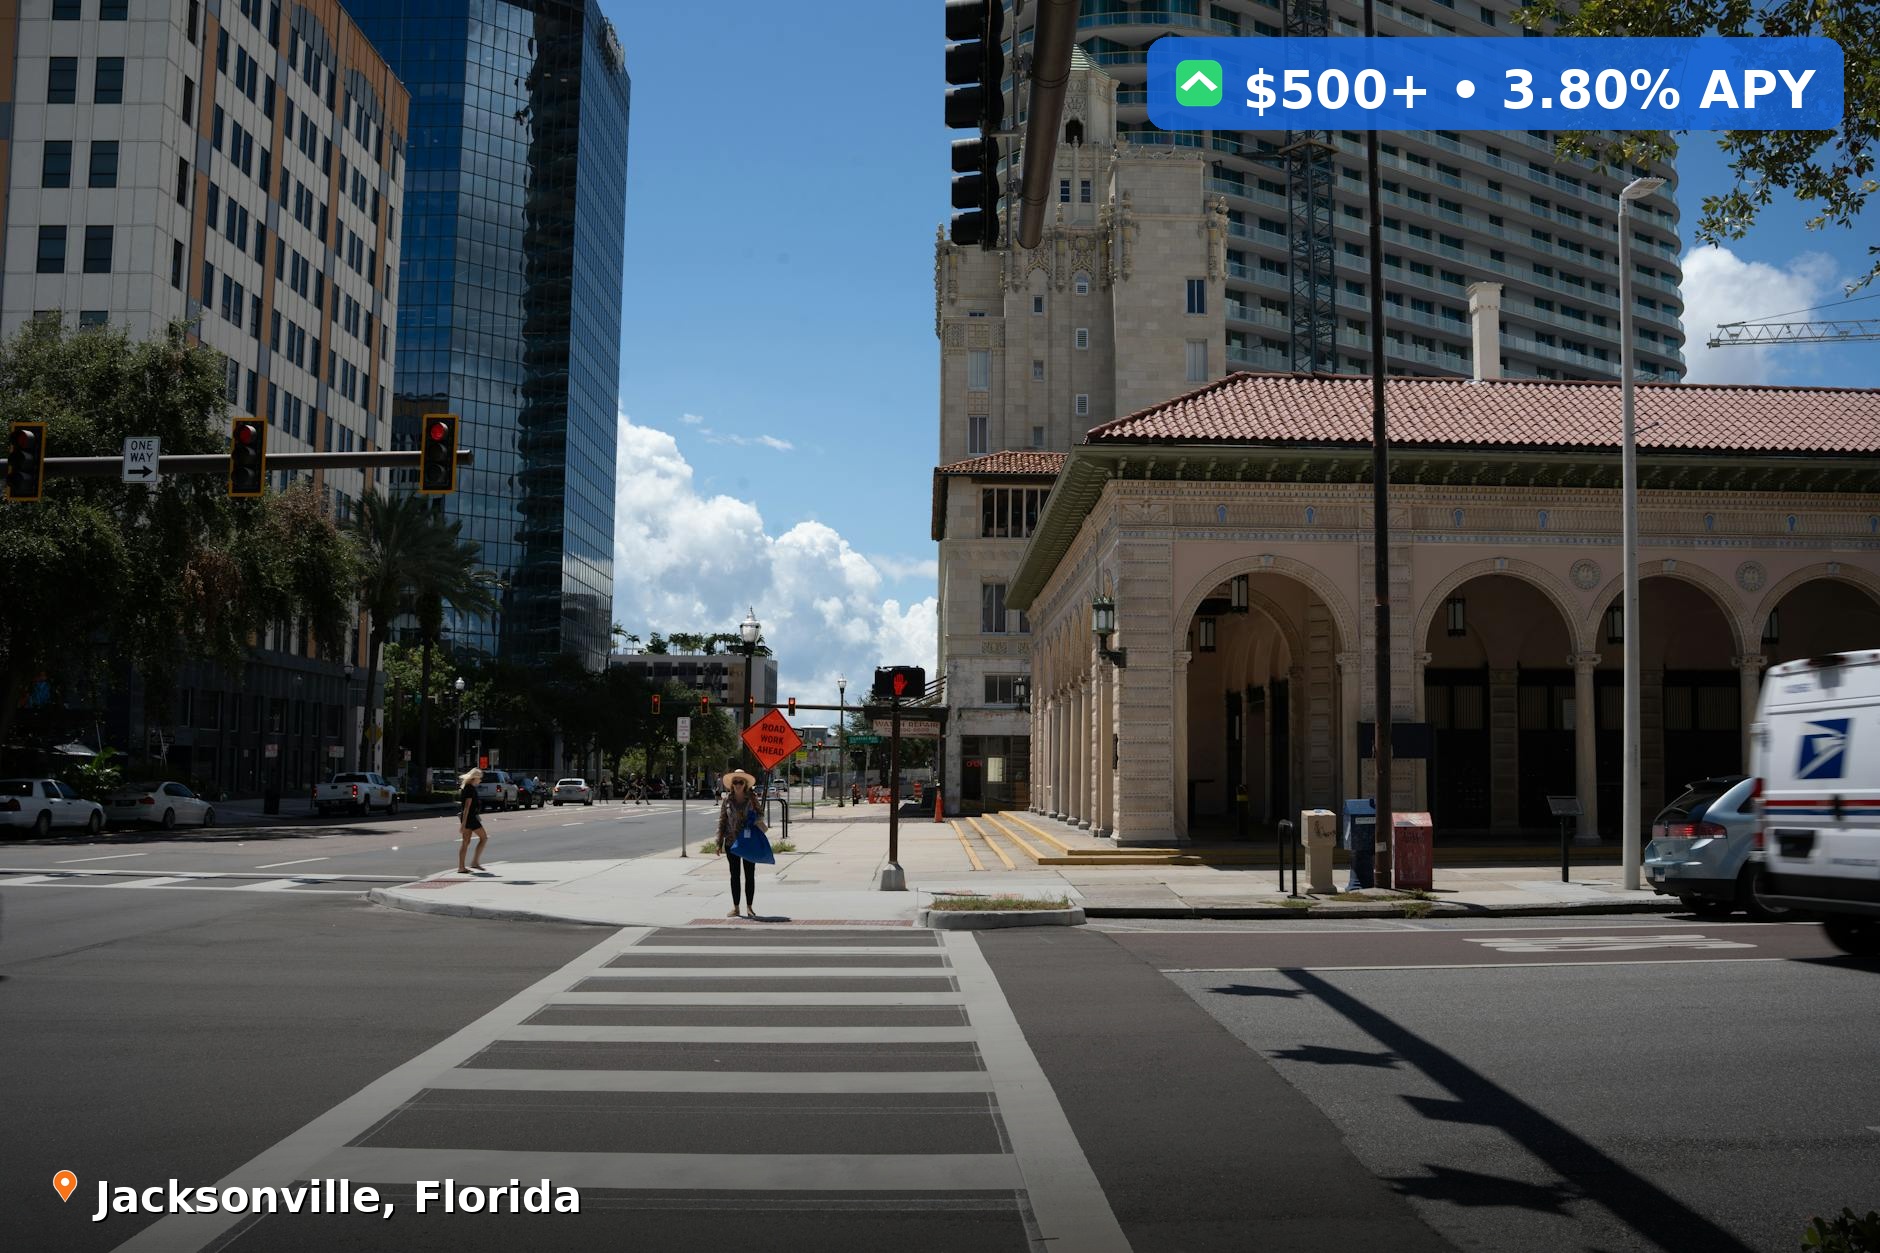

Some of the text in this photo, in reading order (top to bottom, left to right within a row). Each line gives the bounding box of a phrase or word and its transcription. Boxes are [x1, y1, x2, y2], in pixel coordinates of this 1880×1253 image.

[131, 440, 153, 451] ONE
[130, 452, 154, 463] WAY
[762, 723, 786, 734] ROAD
[908, 720, 939, 729] REPAIR
[761, 734, 784, 745] WORK
[757, 745, 785, 756] AHEAD
